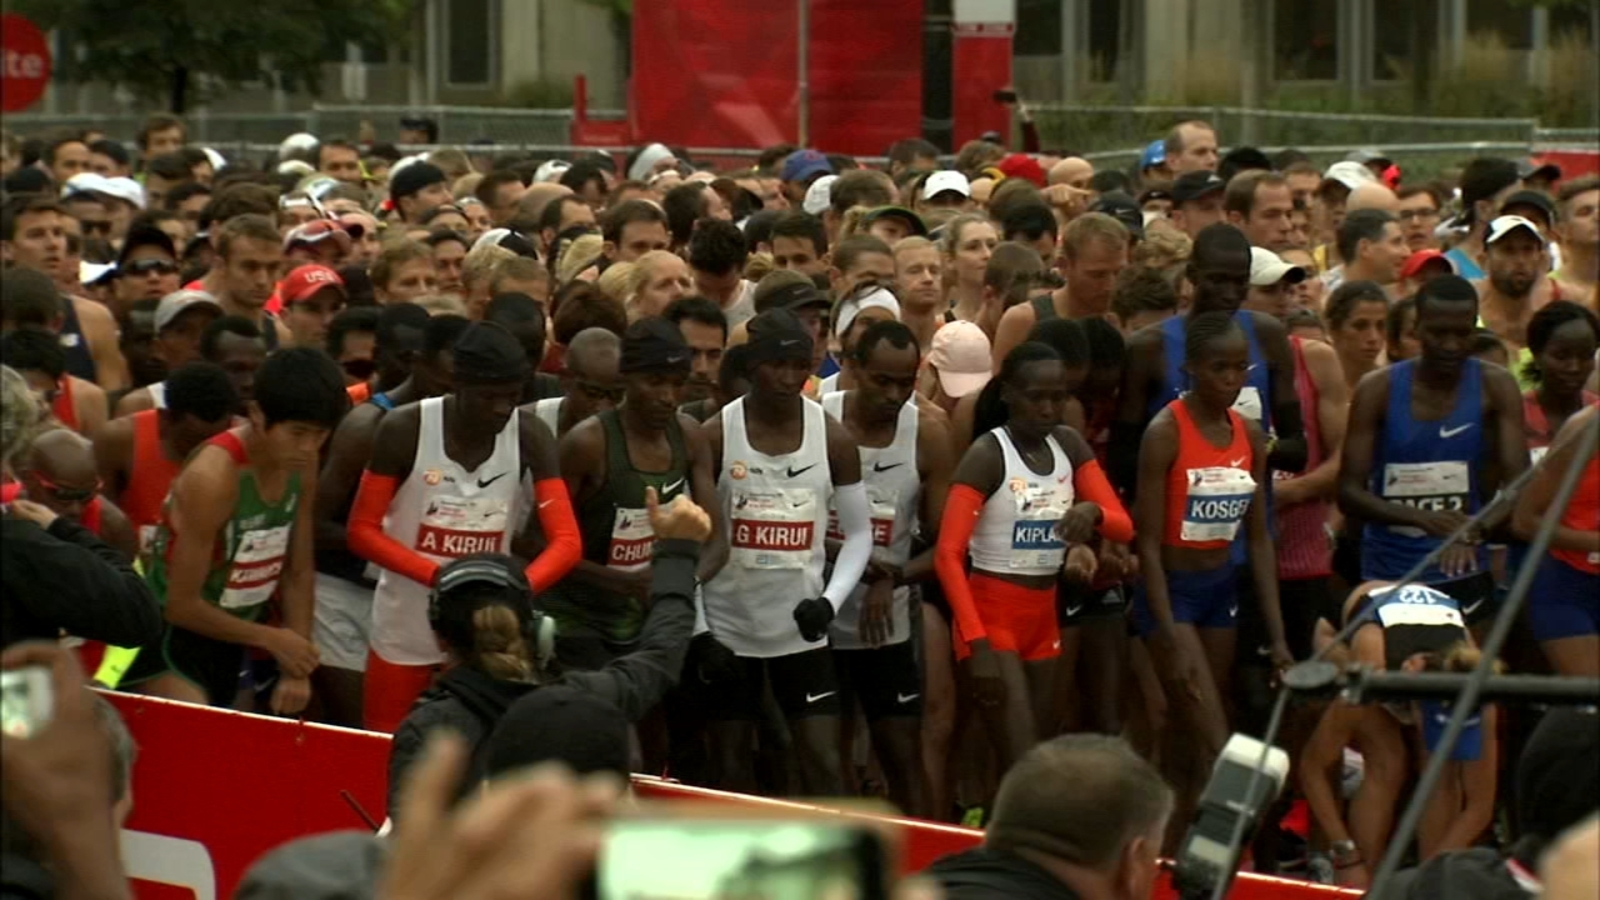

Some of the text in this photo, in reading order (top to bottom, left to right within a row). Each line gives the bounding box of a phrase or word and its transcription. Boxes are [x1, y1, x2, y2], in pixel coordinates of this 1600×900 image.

[421, 531, 437, 551] A
[737, 524, 749, 543] G
[756, 525, 807, 547] KIRUI
